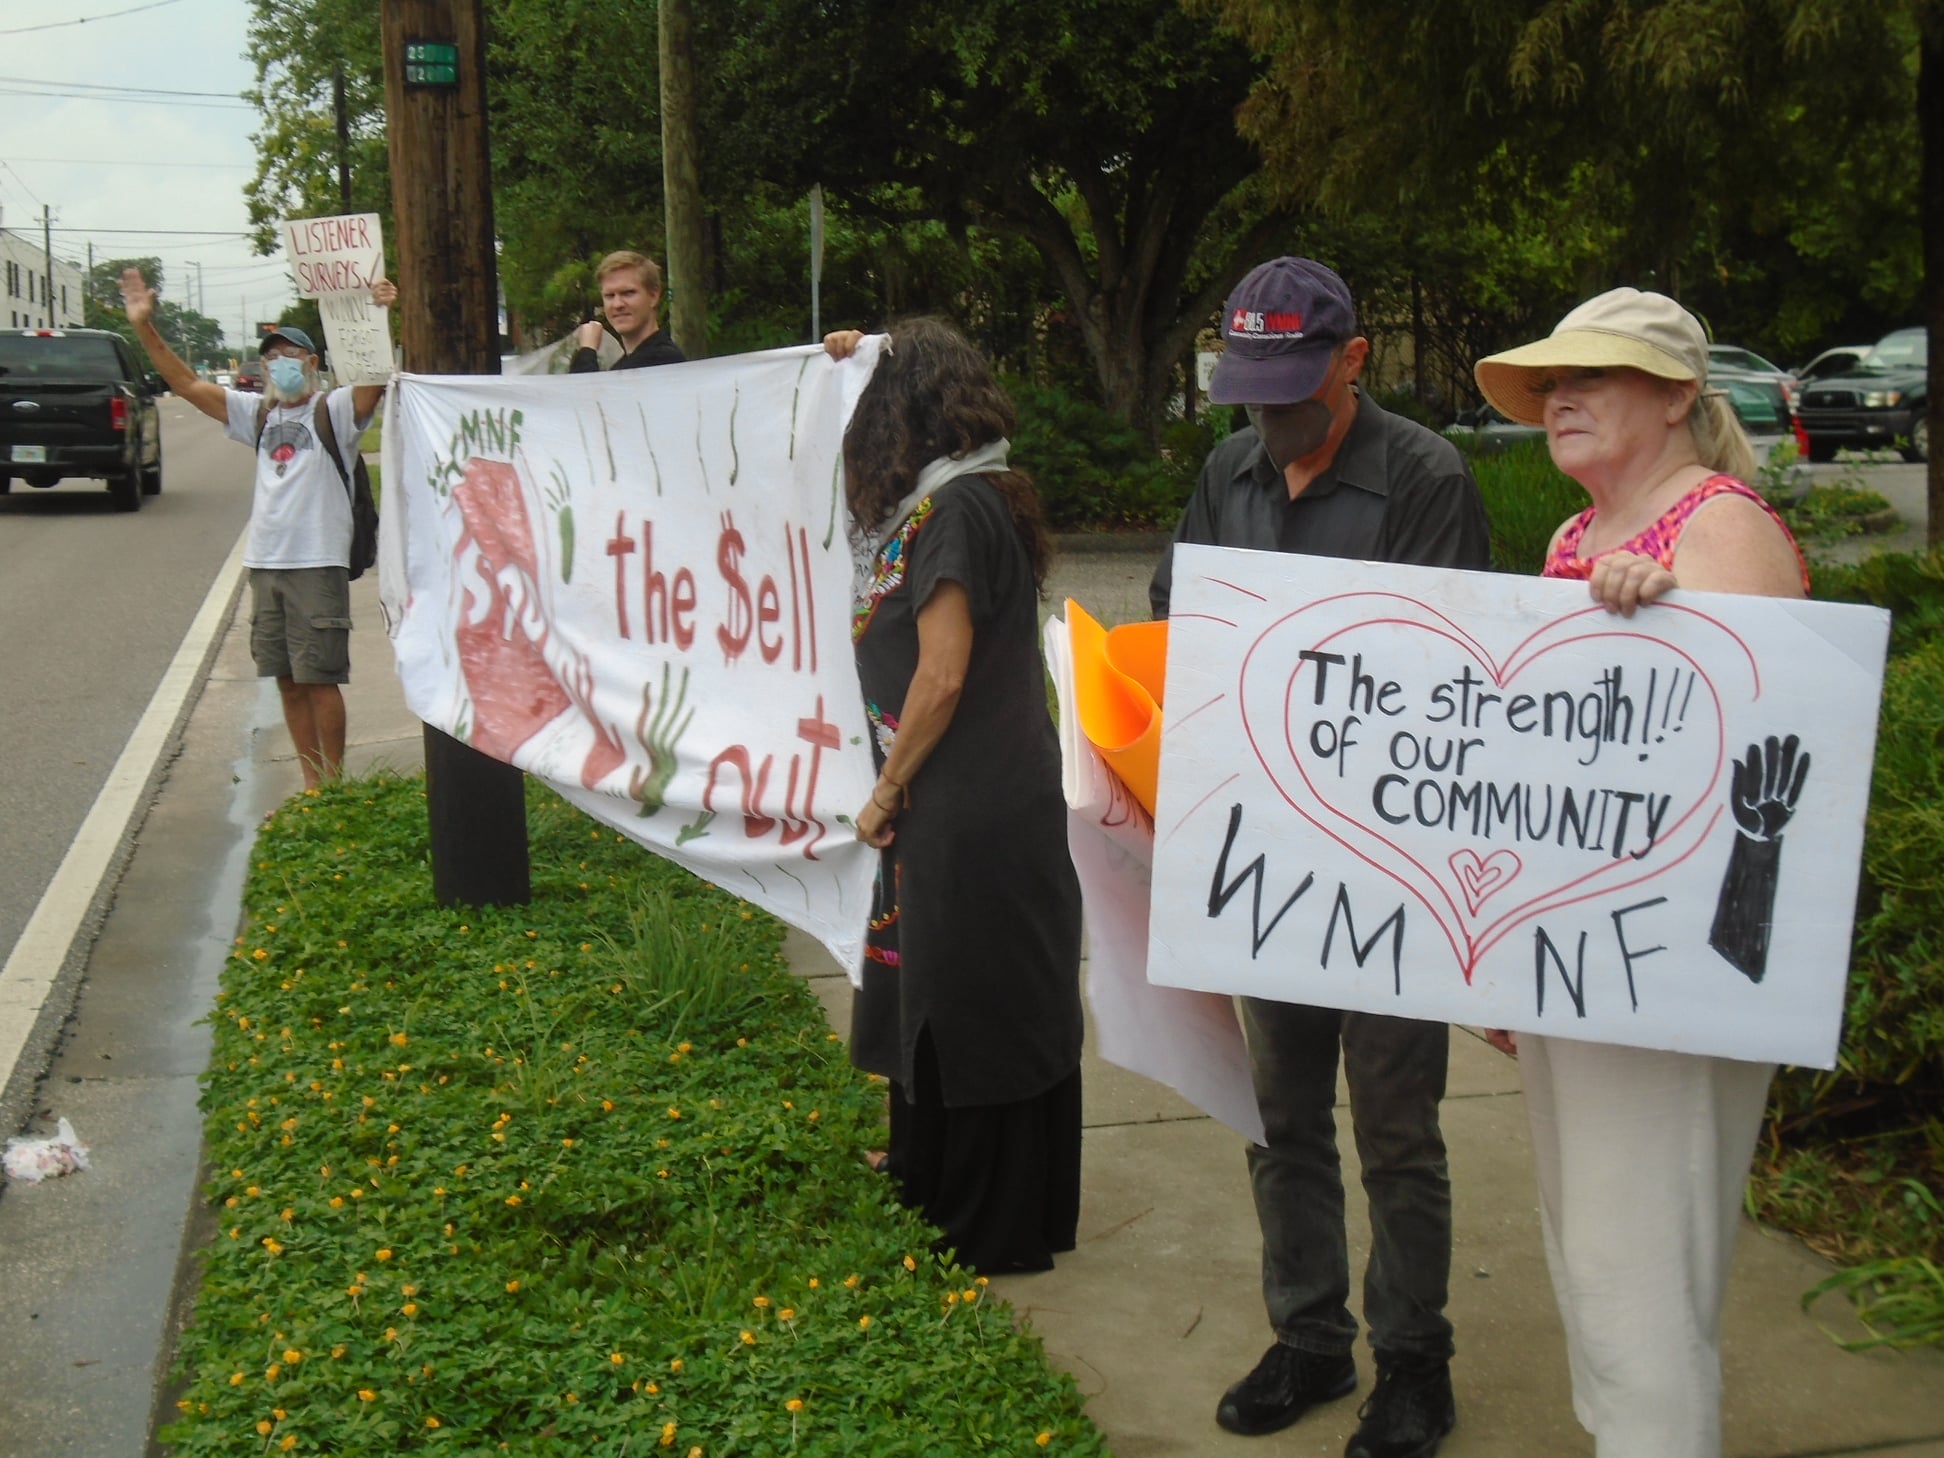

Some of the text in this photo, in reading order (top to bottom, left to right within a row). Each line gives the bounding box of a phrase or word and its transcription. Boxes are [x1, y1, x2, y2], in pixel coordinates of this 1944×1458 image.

[290, 217, 372, 255] LISTENER
[299, 260, 361, 293] SURVEYS
[606, 510, 697, 651] the
[717, 508, 818, 676] $ell
[1299, 650, 1407, 716] The
[1310, 713, 1486, 777] of our
[1372, 773, 1672, 860] COMMUNITY
